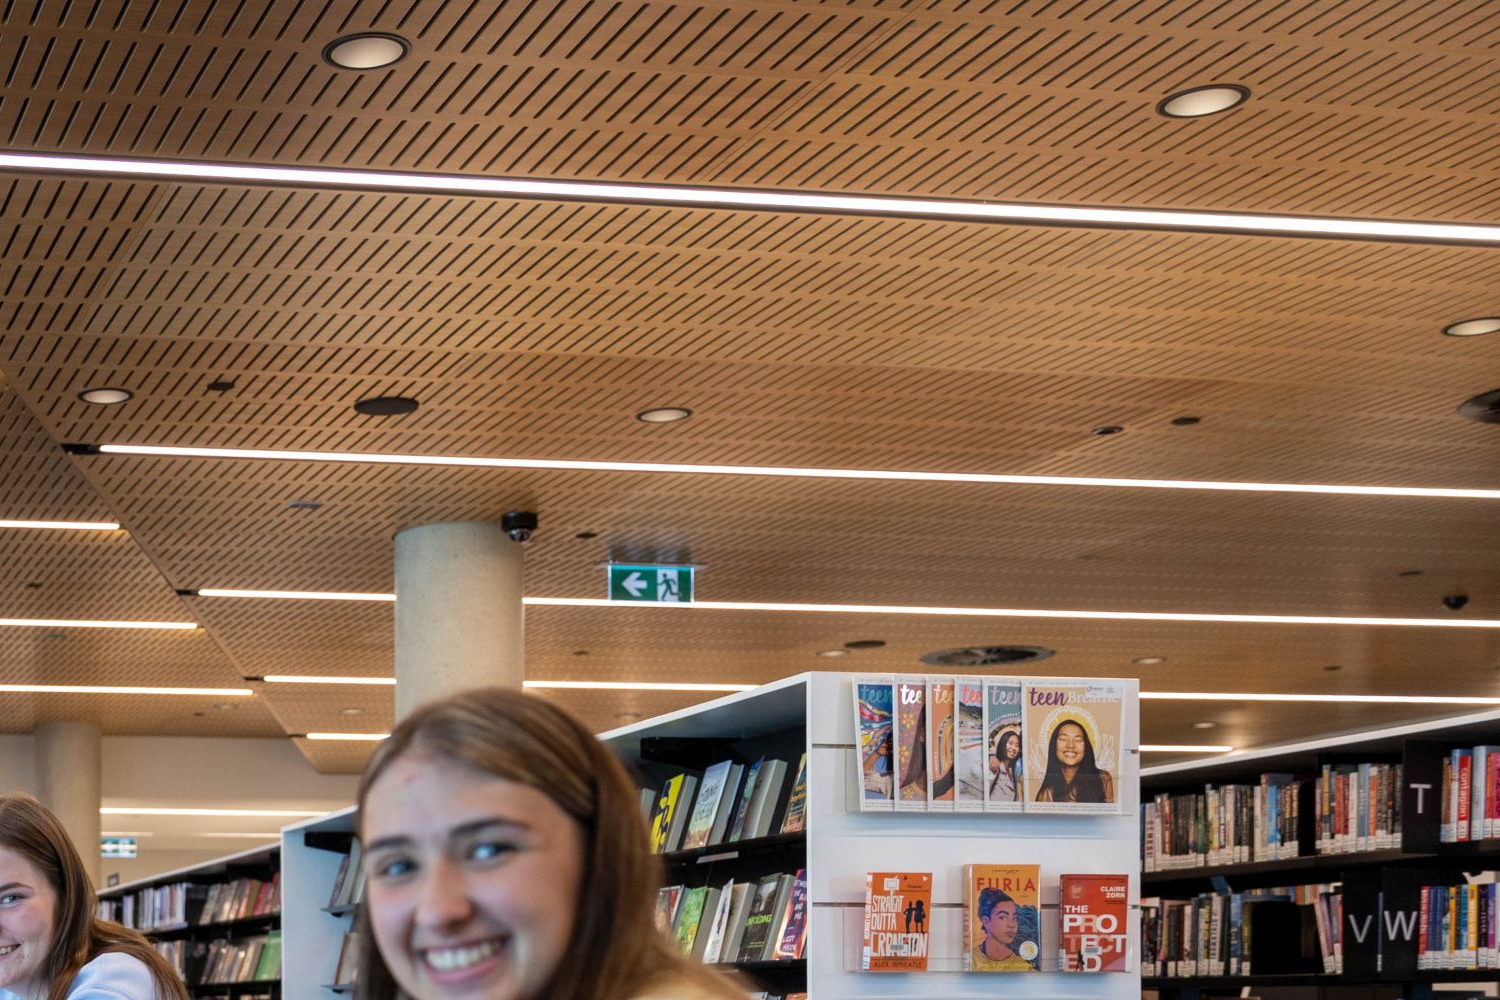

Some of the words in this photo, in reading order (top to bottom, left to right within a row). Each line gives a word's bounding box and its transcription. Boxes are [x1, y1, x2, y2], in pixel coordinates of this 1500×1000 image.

[1028, 687, 1069, 706] teen
[1410, 783, 1431, 814] T
[1459, 767, 1469, 817] contagion
[976, 877, 1036, 892] FURIA
[872, 895, 904, 912] STRAIGHT
[1063, 904, 1089, 913] THE
[871, 913, 897, 930] OUTTA
[1063, 913, 1118, 933] PRO
[1348, 914, 1373, 944] V
[1384, 911, 1418, 941] W
[873, 960, 889, 968] ALEX
